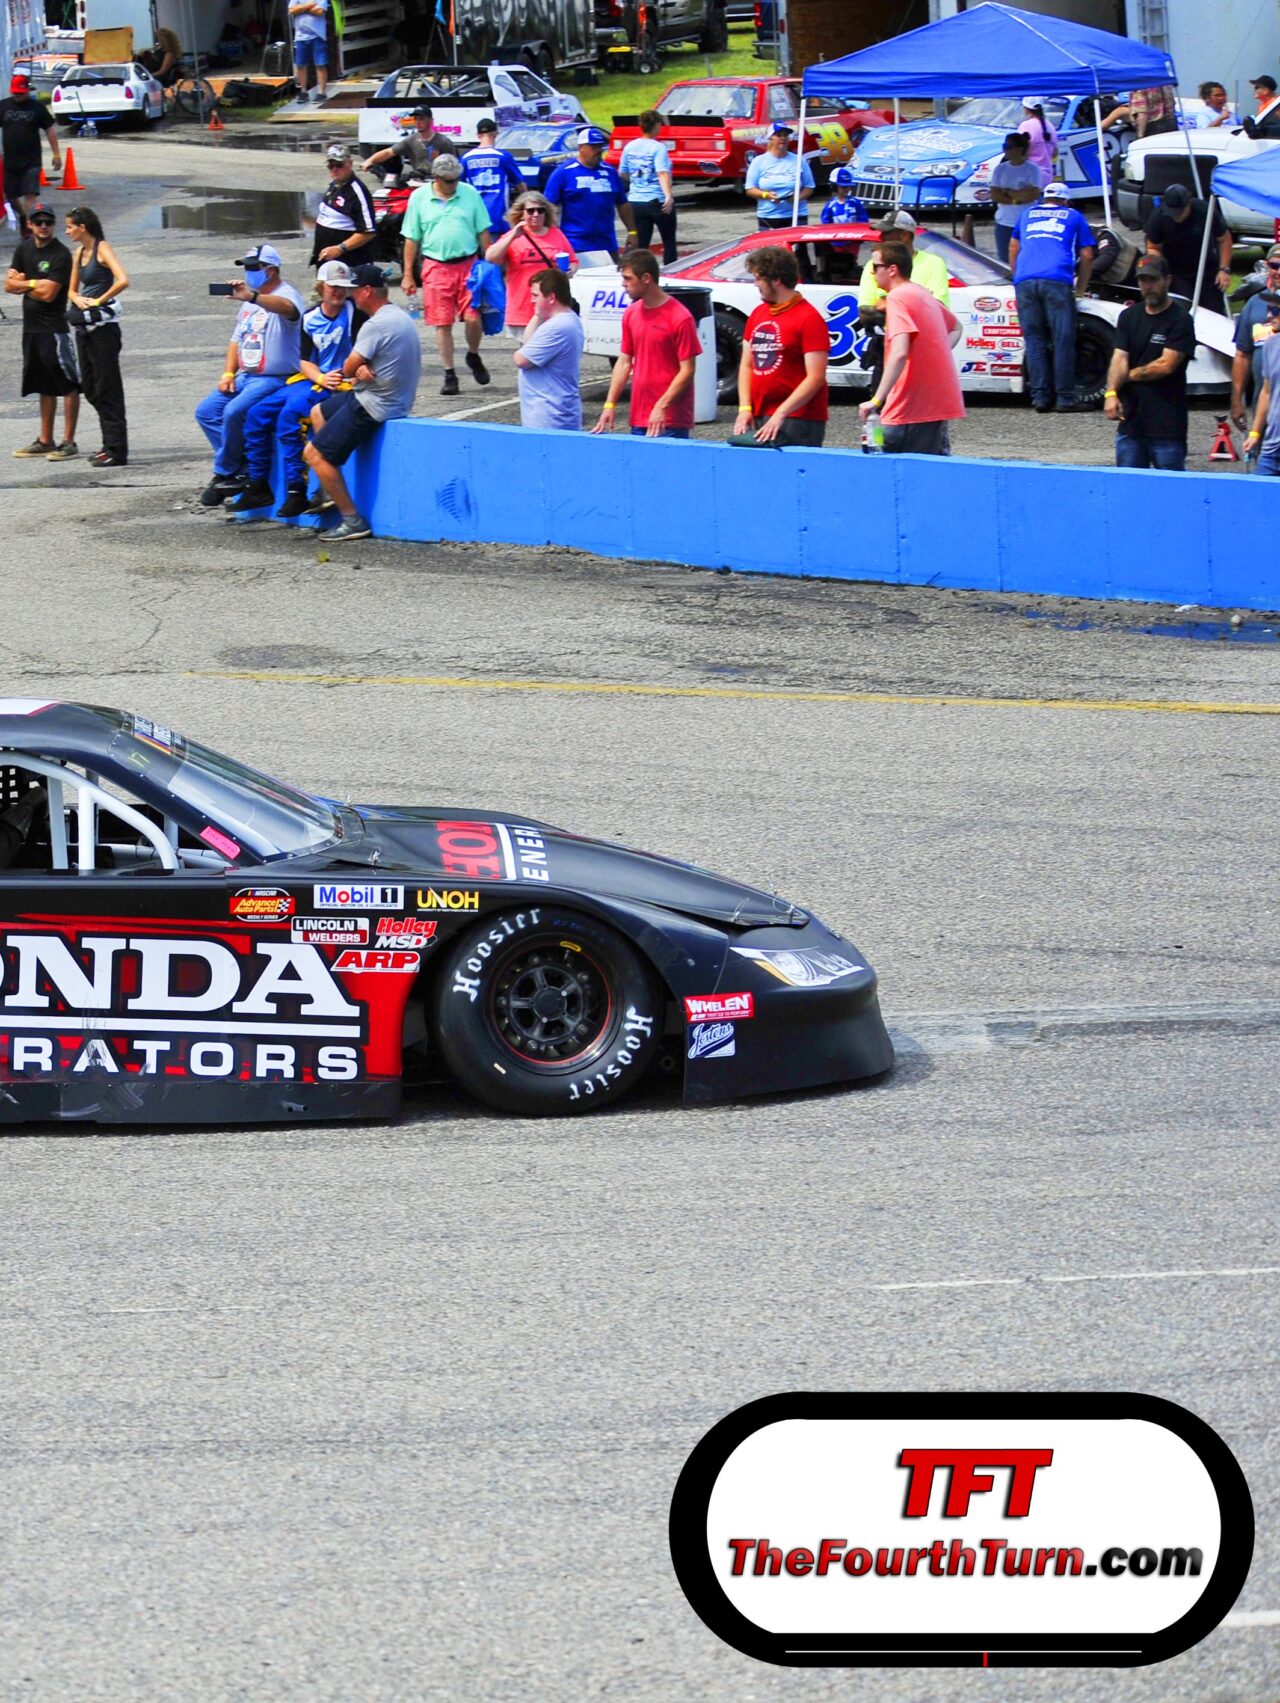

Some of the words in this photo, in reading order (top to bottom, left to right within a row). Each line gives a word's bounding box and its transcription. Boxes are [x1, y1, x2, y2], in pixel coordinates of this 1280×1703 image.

[591, 290, 628, 308] PAL
[238, 898, 276, 907] Advance
[319, 886, 373, 903] Mobil
[417, 888, 479, 909] UNOH
[295, 919, 355, 931] LINCOLN
[376, 917, 437, 935] Holley
[308, 932, 361, 943] WELDERS
[375, 935, 428, 949] MSD
[335, 951, 418, 968] ARP
[452, 908, 541, 1002] Hoosier
[685, 994, 750, 1014] WHELEN
[569, 1005, 654, 1101] Hoosier
